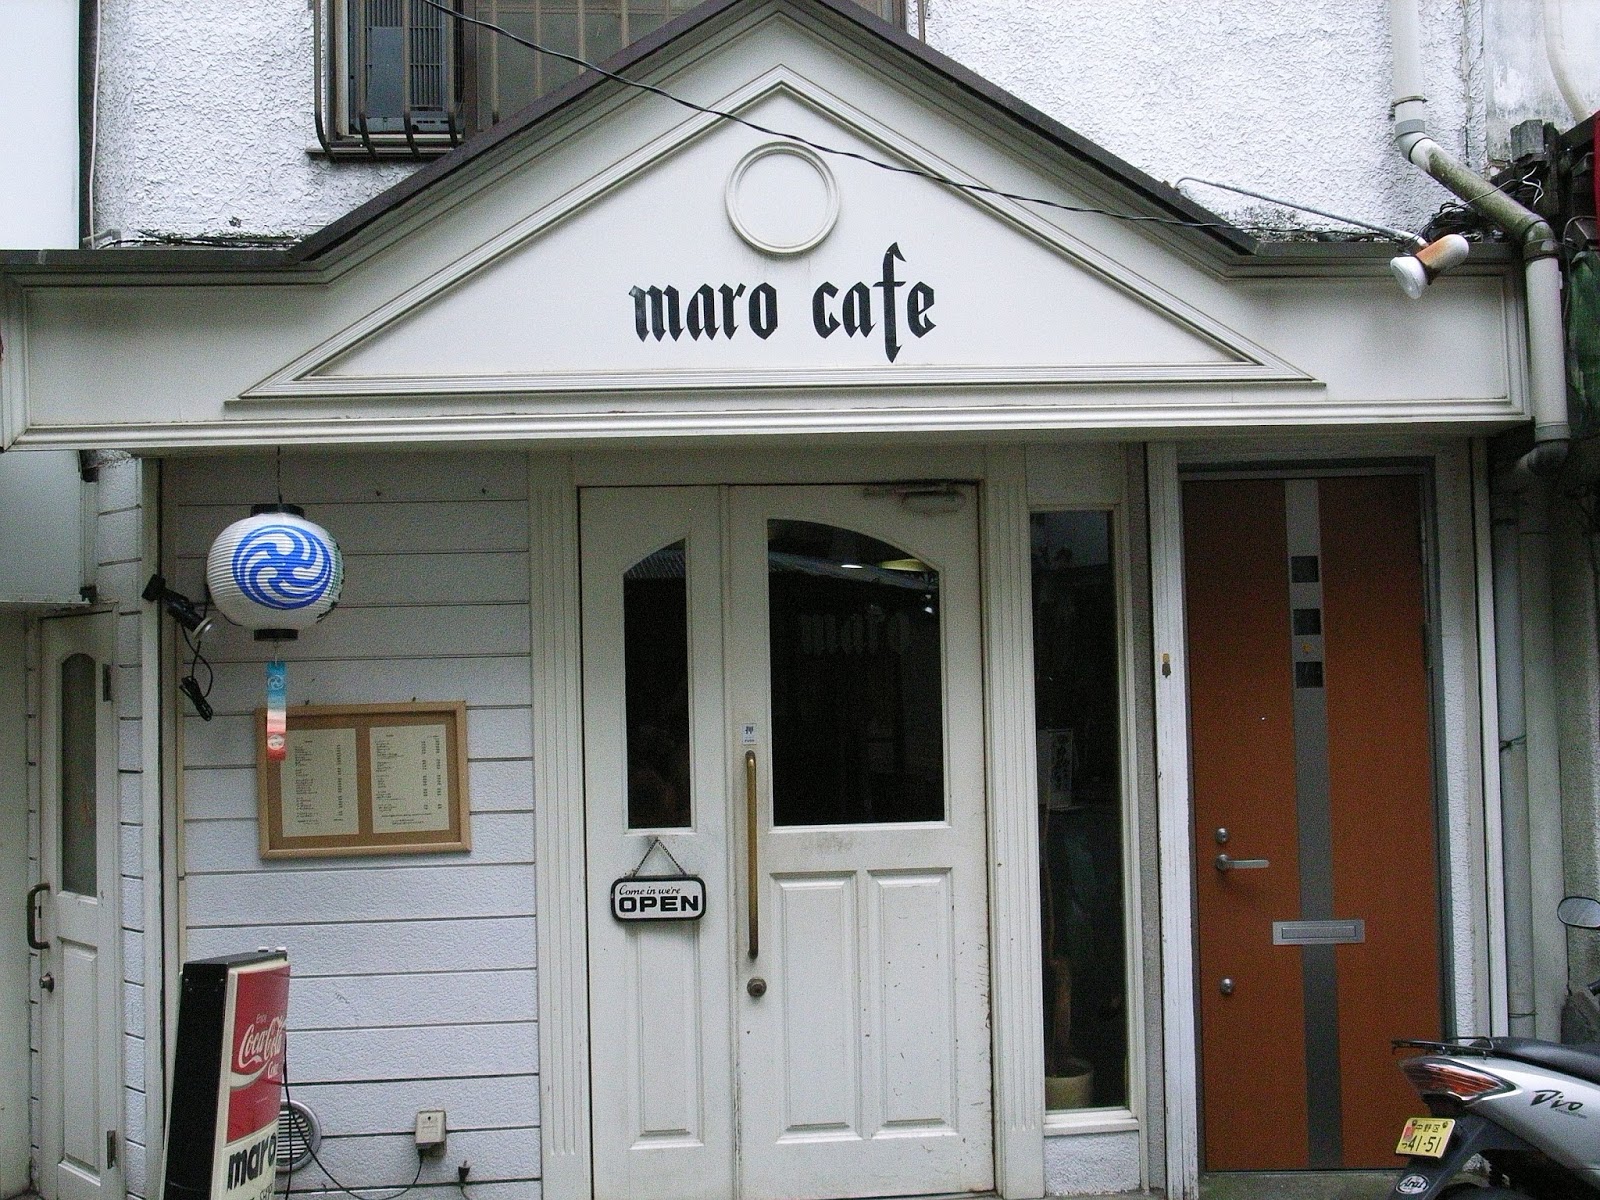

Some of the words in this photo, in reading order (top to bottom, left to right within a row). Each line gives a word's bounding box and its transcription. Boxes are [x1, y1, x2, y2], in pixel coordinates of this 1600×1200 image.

[628, 282, 778, 342] maro
[812, 241, 937, 363] cafe
[619, 884, 645, 895] Come
[646, 886, 656, 895] in
[658, 886, 681, 895] we're
[618, 895, 699, 912] OPEN
[1530, 1089, 1583, 1111] Dio
[1415, 1123, 1441, 1133] 中野区
[226, 1132, 276, 1193] maro
